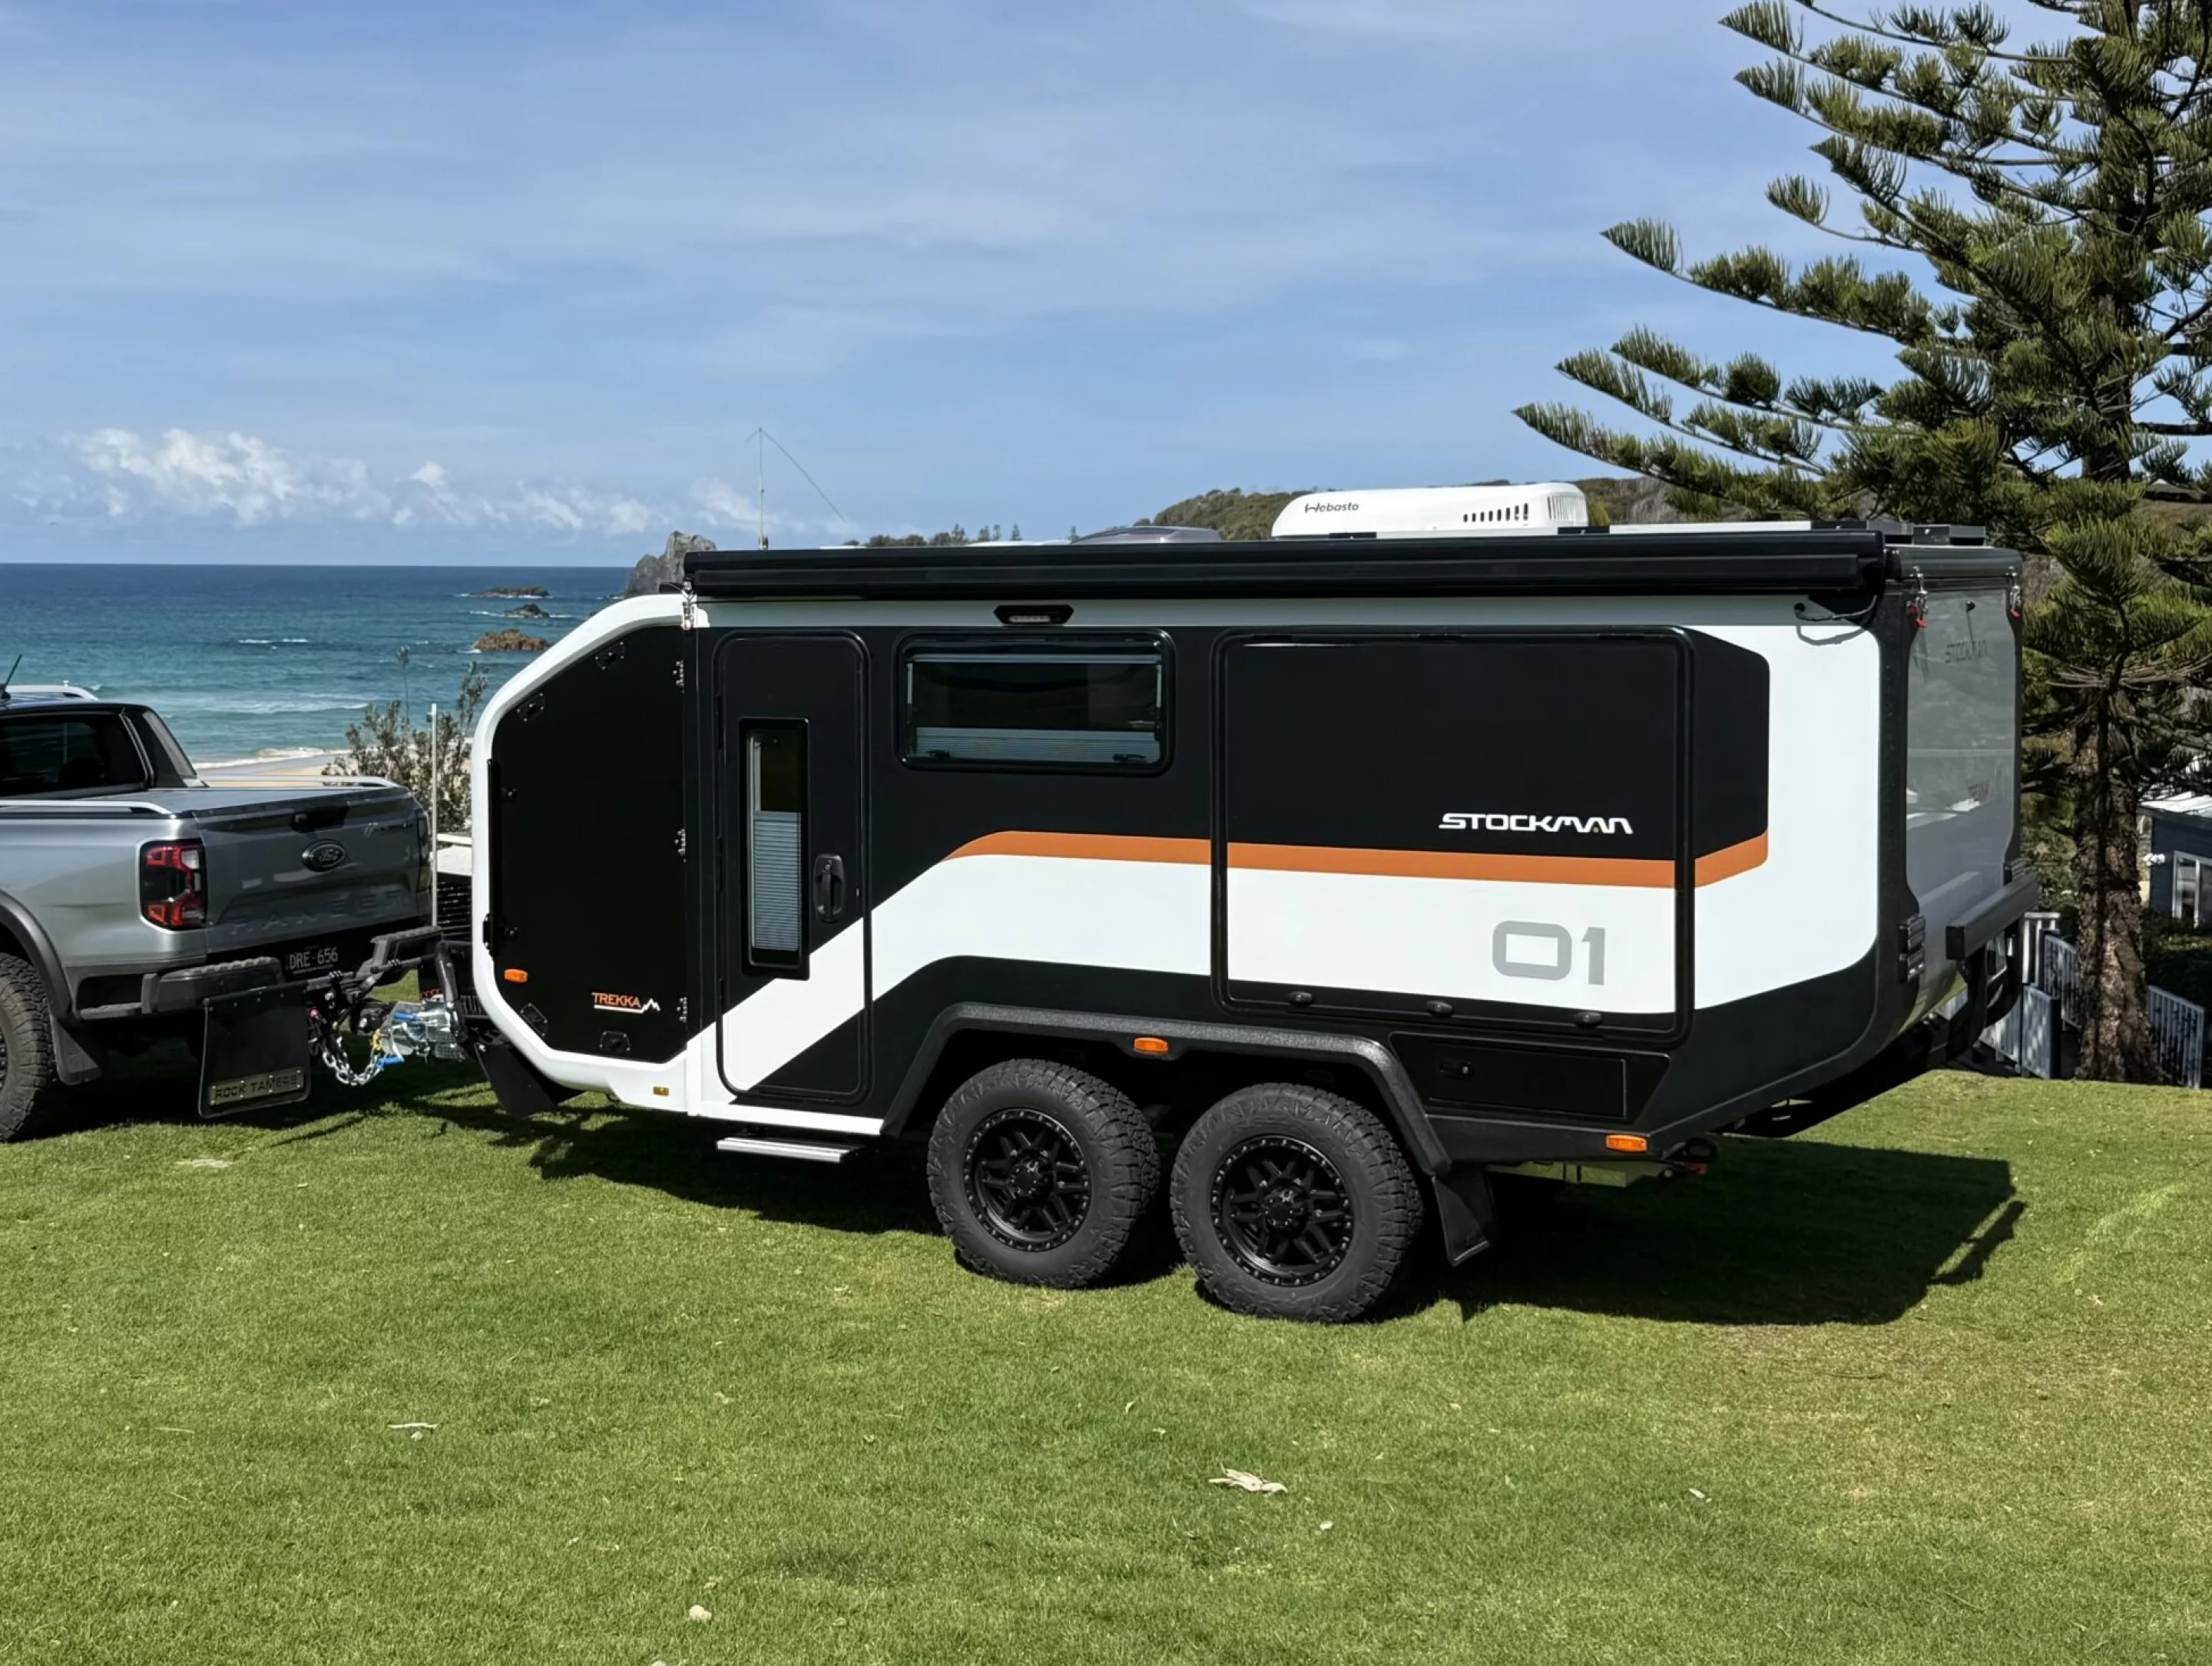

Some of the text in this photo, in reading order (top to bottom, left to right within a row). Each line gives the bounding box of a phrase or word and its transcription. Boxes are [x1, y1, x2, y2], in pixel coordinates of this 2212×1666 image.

[1304, 502, 1359, 513] Webasto
[1438, 813, 1634, 835] STOCKMAN
[289, 952, 311, 970] DRE
[317, 946, 339, 965] 656
[1492, 919, 1606, 986] 01
[591, 992, 641, 1008] TREKKA
[215, 1084, 247, 1099] ROCK
